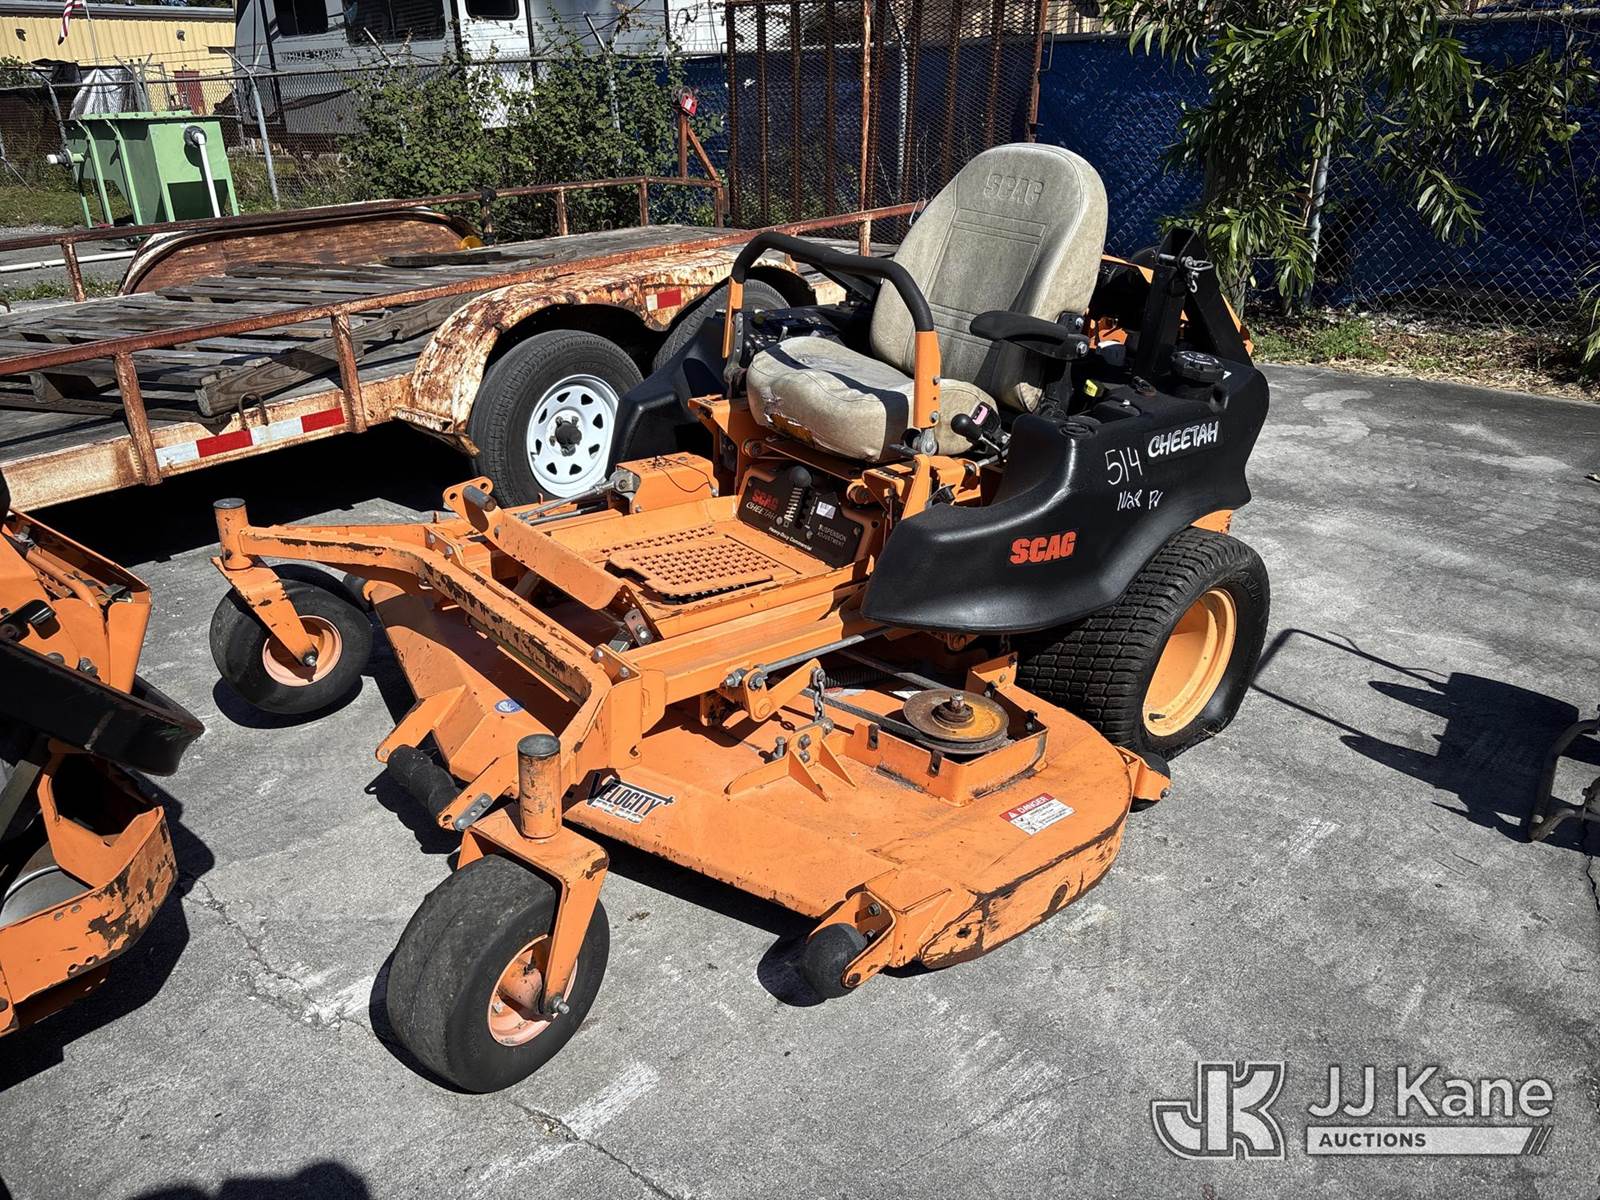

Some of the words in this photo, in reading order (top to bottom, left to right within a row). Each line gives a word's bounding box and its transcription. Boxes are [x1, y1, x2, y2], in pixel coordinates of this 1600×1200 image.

[983, 173, 1044, 206] SCAG
[1147, 420, 1219, 458] CHEETAH
[1105, 447, 1143, 485] 514
[746, 501, 778, 521] CHEETAH
[1009, 531, 1077, 564] SCAG
[586, 773, 662, 816] VELOCITY
[1017, 796, 1050, 814] DANGER
